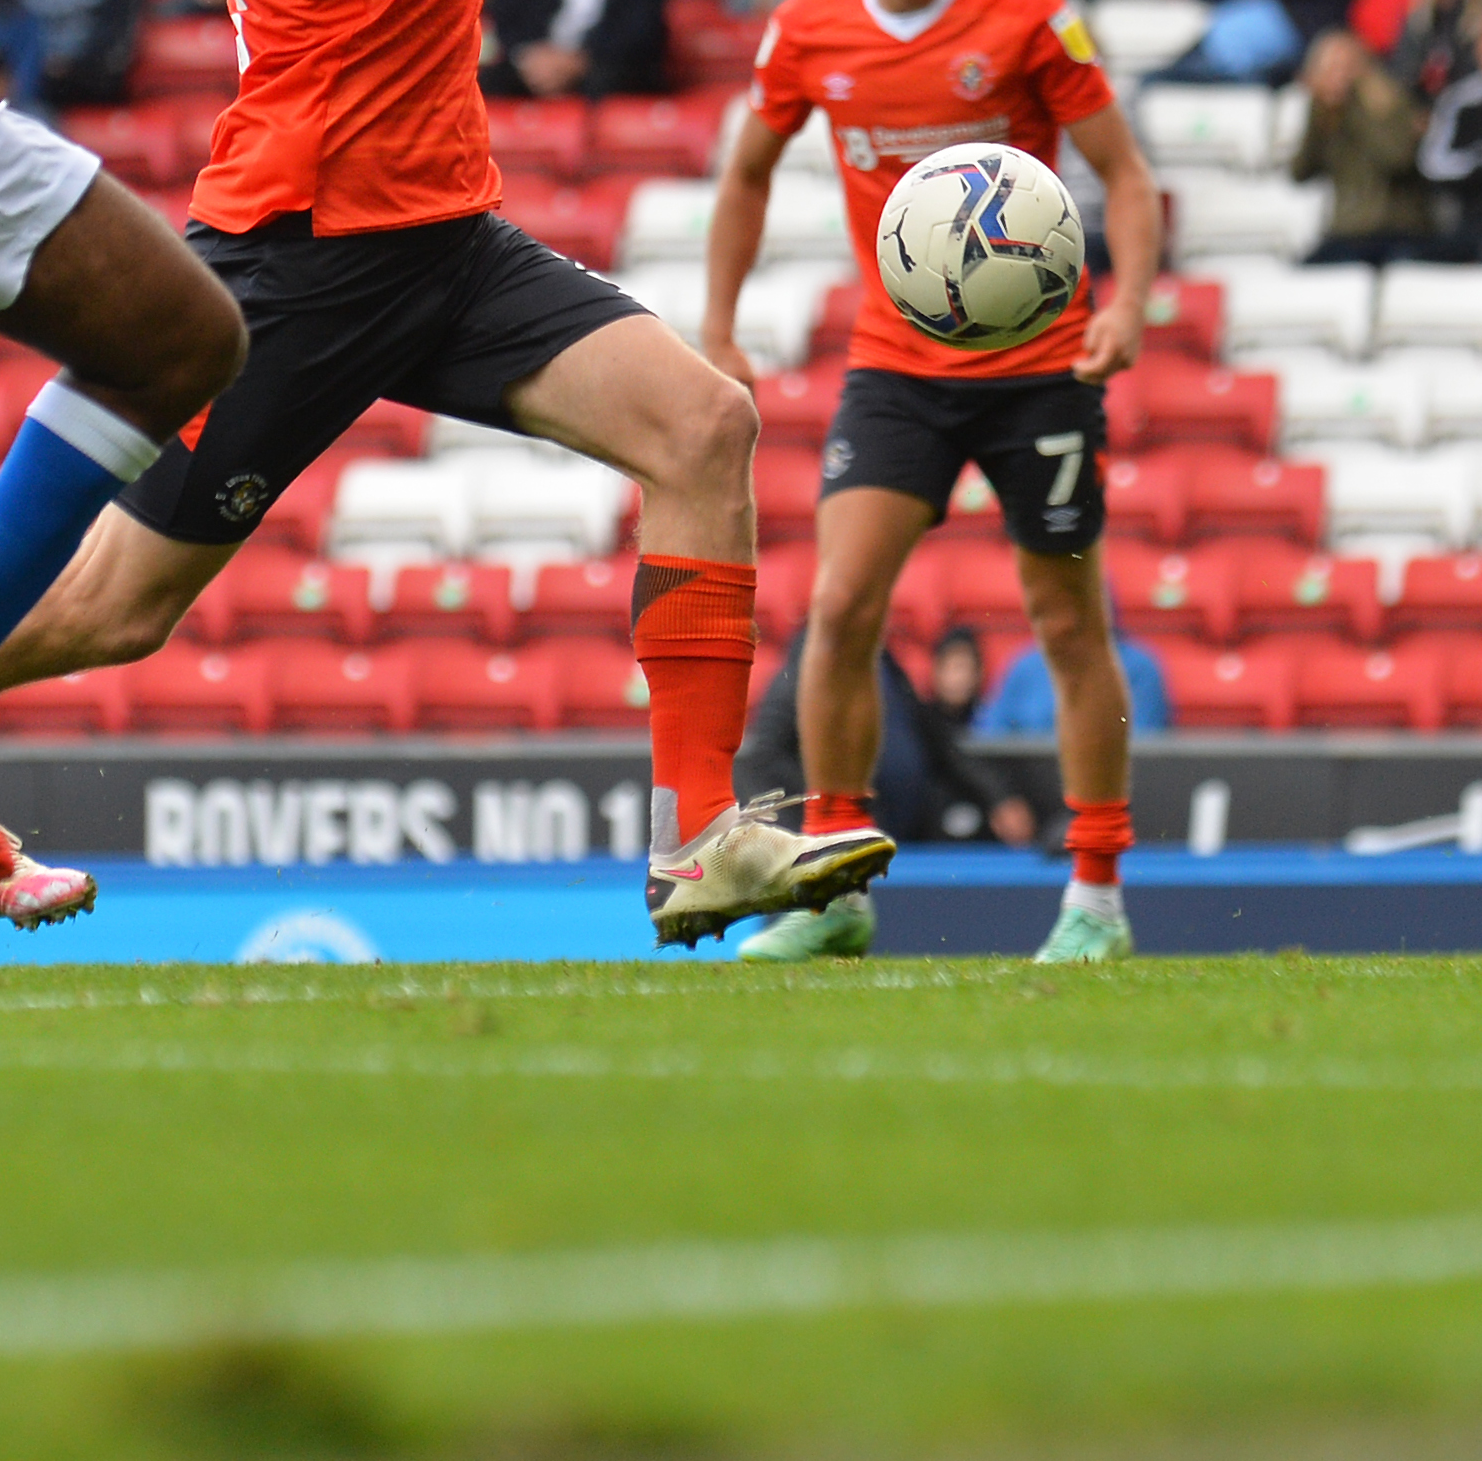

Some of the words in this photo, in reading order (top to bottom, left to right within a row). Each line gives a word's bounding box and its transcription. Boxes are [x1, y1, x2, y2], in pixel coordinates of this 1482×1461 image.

[1034, 431, 1085, 507] 7
[144, 778, 460, 868] ROVERS
[473, 778, 591, 866] NO
